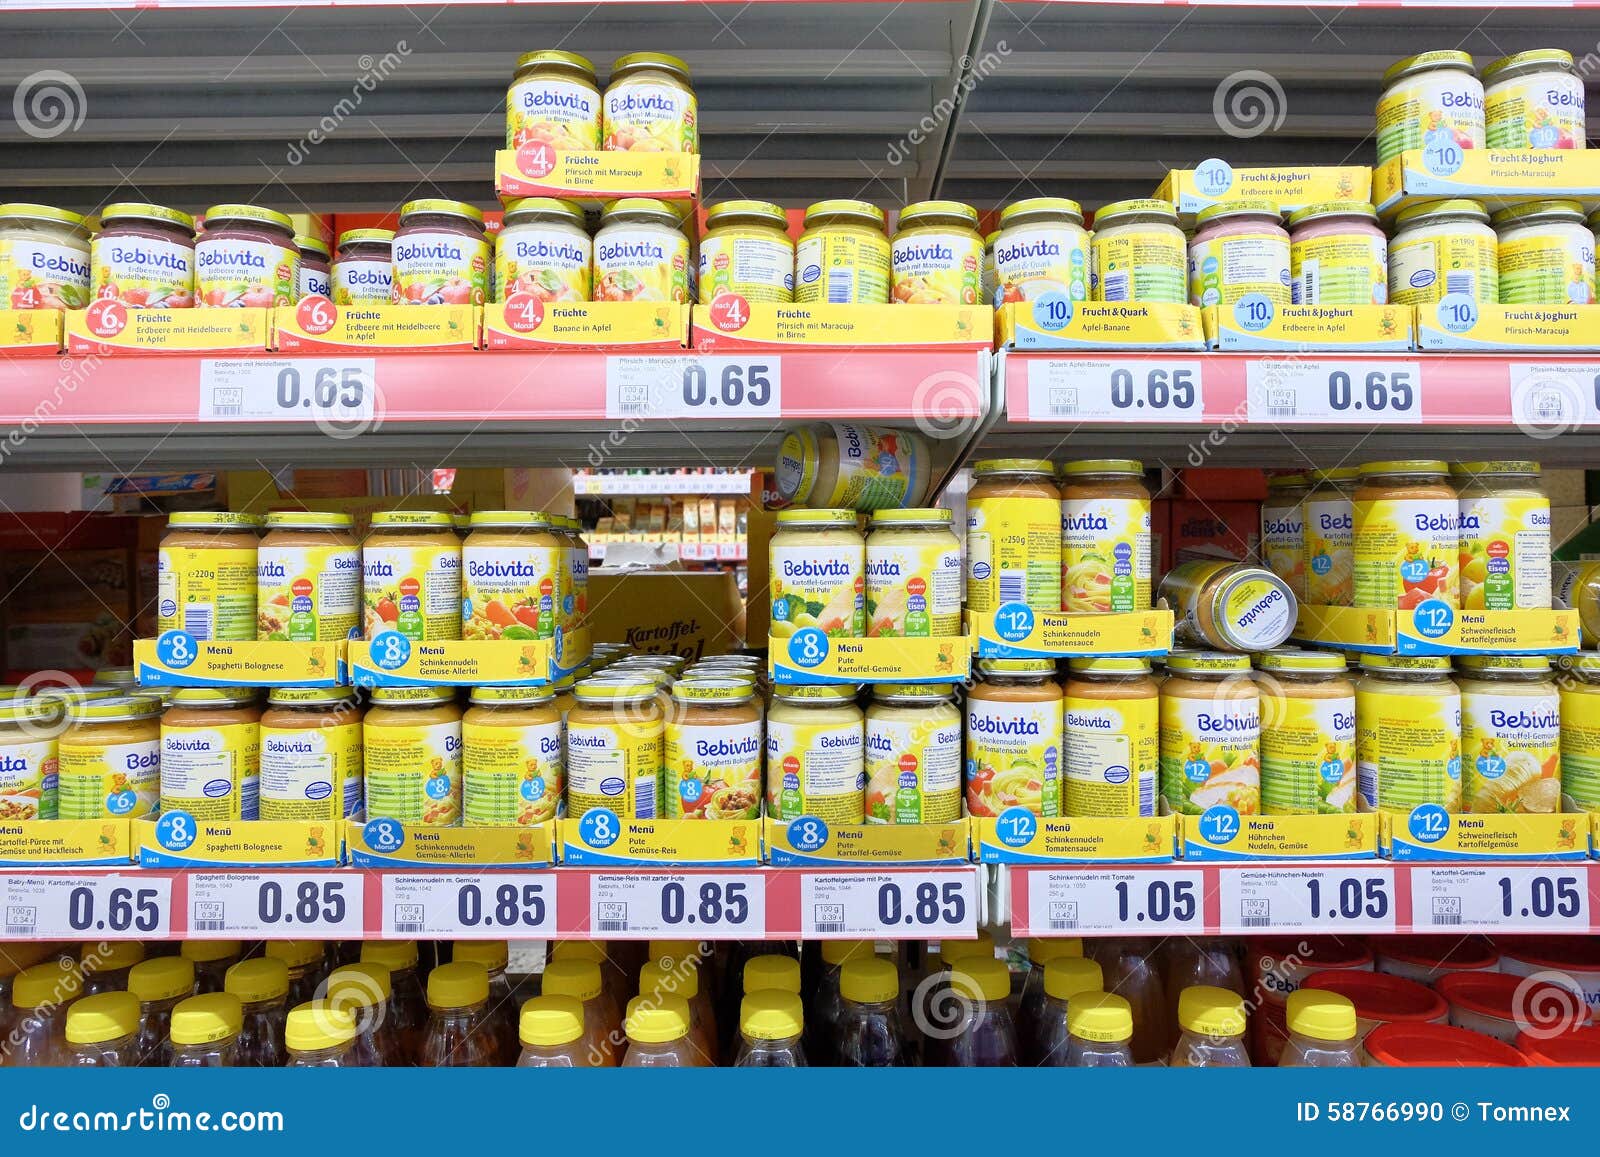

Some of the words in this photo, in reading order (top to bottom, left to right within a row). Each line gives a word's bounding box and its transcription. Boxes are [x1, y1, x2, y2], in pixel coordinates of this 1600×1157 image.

[524, 91, 589, 112] Bebivita
[566, 156, 599, 165] Früchte
[610, 169, 642, 177] Maracuja
[1241, 188, 1272, 196] Erdbeere
[1284, 188, 1303, 196] Apfel
[112, 248, 186, 271] Bebivita
[397, 243, 461, 261] Bebivita
[517, 242, 583, 263] Bebivita
[600, 243, 663, 261] Bebivita
[102, 305, 124, 328] 6.
[137, 315, 171, 323] Früchte
[312, 301, 334, 326] 6.
[347, 311, 380, 320] Früchte
[521, 300, 541, 322] 4.
[553, 309, 587, 317] Früchte
[726, 300, 747, 322] 4.
[777, 310, 811, 319] Früchte
[1046, 301, 1070, 320] 10.
[1247, 302, 1271, 320] 10.
[1450, 304, 1475, 322] 10.
[137, 326, 170, 334] Erdbeere
[592, 324, 611, 332] Apfel
[777, 322, 804, 330] Pfirsich
[821, 322, 854, 331] Maracuja
[786, 331, 805, 339] Birne
[1282, 324, 1314, 332] Erdbeere
[1326, 323, 1345, 332] Apfel
[1505, 327, 1569, 335] Pfirsich-Maracuja
[146, 335, 166, 343] Apfel
[356, 332, 375, 340] Apfel
[277, 368, 363, 408] 0.65
[683, 365, 770, 406] 0.65
[1111, 369, 1194, 408] 0.65
[1328, 371, 1412, 410] 0.65
[470, 561, 534, 576] Bebivita
[784, 559, 849, 576] Bebivita
[1007, 612, 1032, 630] 12.
[1043, 618, 1068, 626] Menü
[1428, 609, 1450, 626] 12.
[1461, 627, 1516, 635] Schweinefleisch
[173, 636, 194, 660] 8.
[208, 646, 232, 655] Menü
[386, 637, 406, 660] 8.
[420, 647, 444, 655] Menü
[804, 634, 825, 658] 8.
[208, 662, 242, 670] Spaghetti
[245, 662, 283, 670] Bolognese
[420, 659, 478, 667] Schinkennudeln
[420, 667, 478, 675] Gemüse-Allerlei
[970, 713, 1039, 734] Bebivita
[172, 817, 193, 841] 8.
[595, 815, 616, 839] 8.
[1009, 817, 1034, 836] 12.
[1212, 815, 1237, 833] 12.
[1422, 813, 1447, 832] 12.
[206, 828, 231, 836] Menü
[379, 823, 400, 844] 8.
[803, 822, 824, 844] 8.
[207, 843, 241, 851] Spaghetti
[244, 843, 282, 851] Bolognese
[259, 881, 345, 923] 0.85
[458, 884, 545, 926] 0.85
[662, 882, 748, 924] 0.85
[878, 882, 965, 925] 0.85
[1115, 881, 1195, 921] 1.05
[1307, 878, 1388, 918] 1.05
[1499, 877, 1580, 917] 1.05
[69, 887, 159, 931] 0.65
